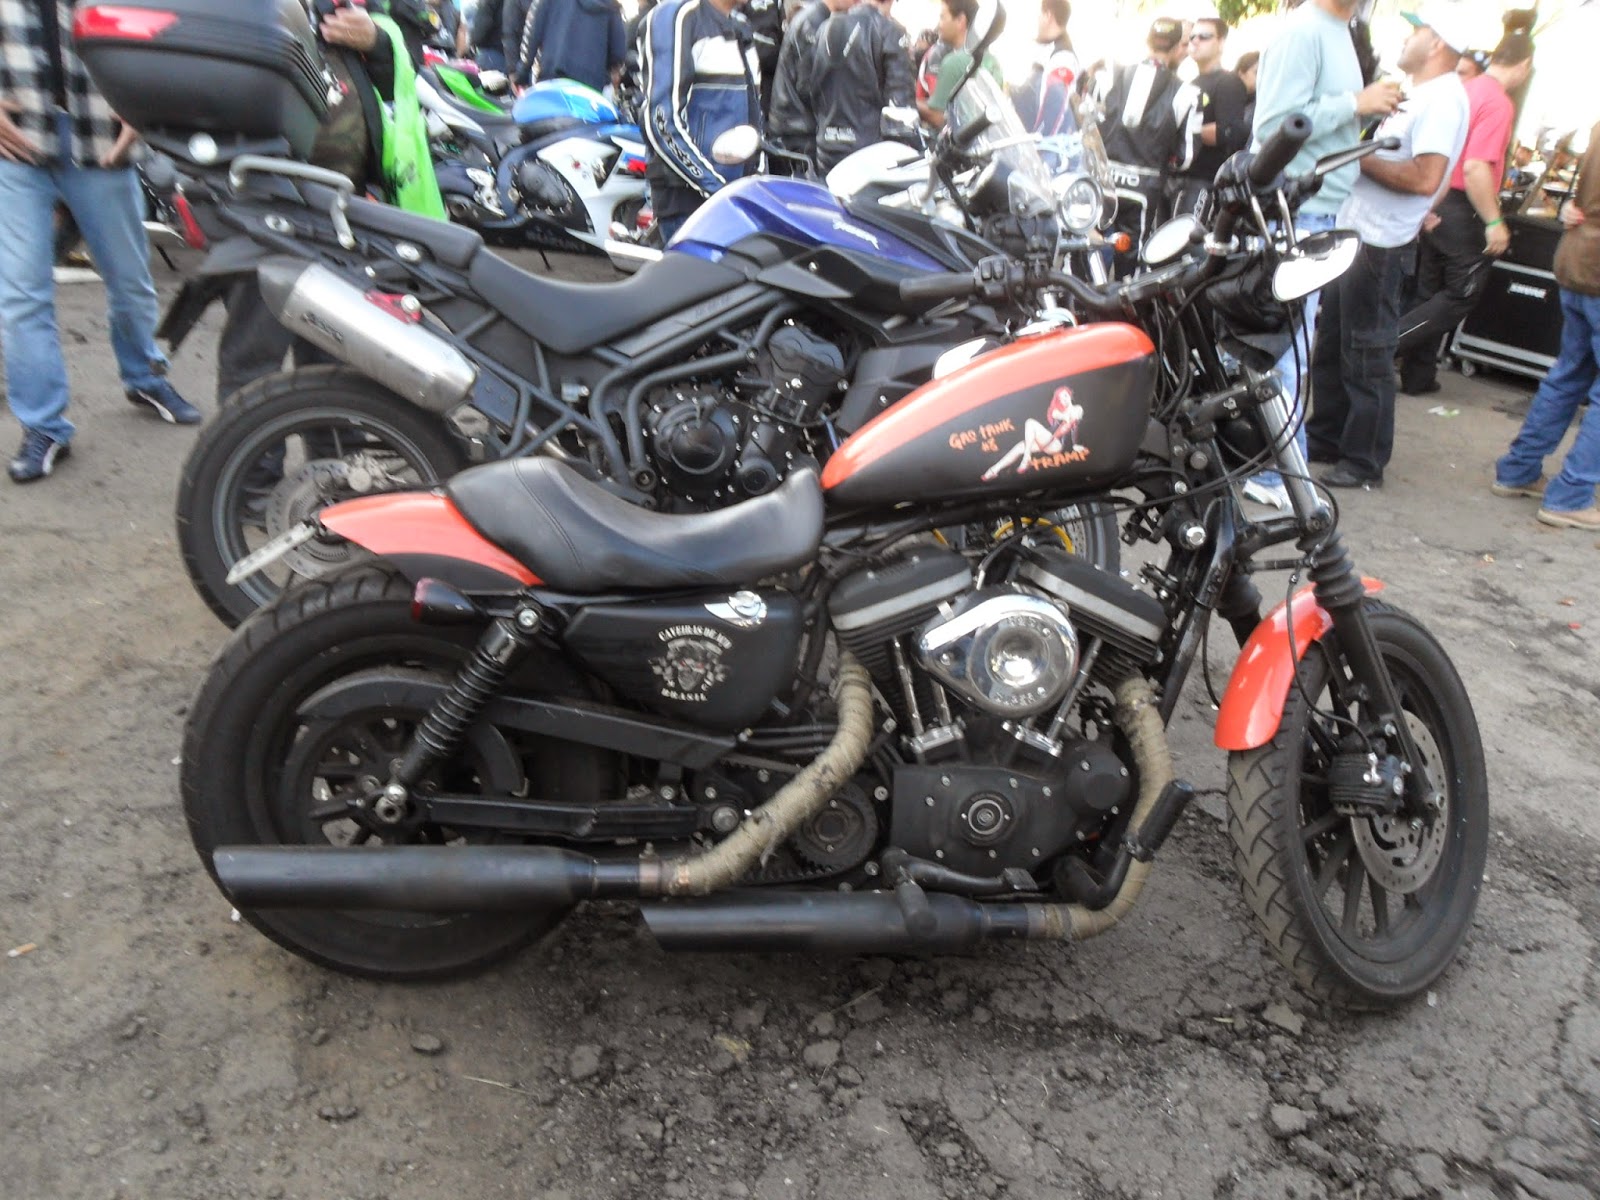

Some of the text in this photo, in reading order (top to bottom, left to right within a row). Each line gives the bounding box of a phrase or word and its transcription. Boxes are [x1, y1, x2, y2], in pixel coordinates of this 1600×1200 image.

[948, 418, 1015, 450] GAS TANK
[1030, 447, 1090, 471] TRAMP
[658, 625, 703, 642] CAVEIRAS
[661, 687, 708, 702] BRASIL
